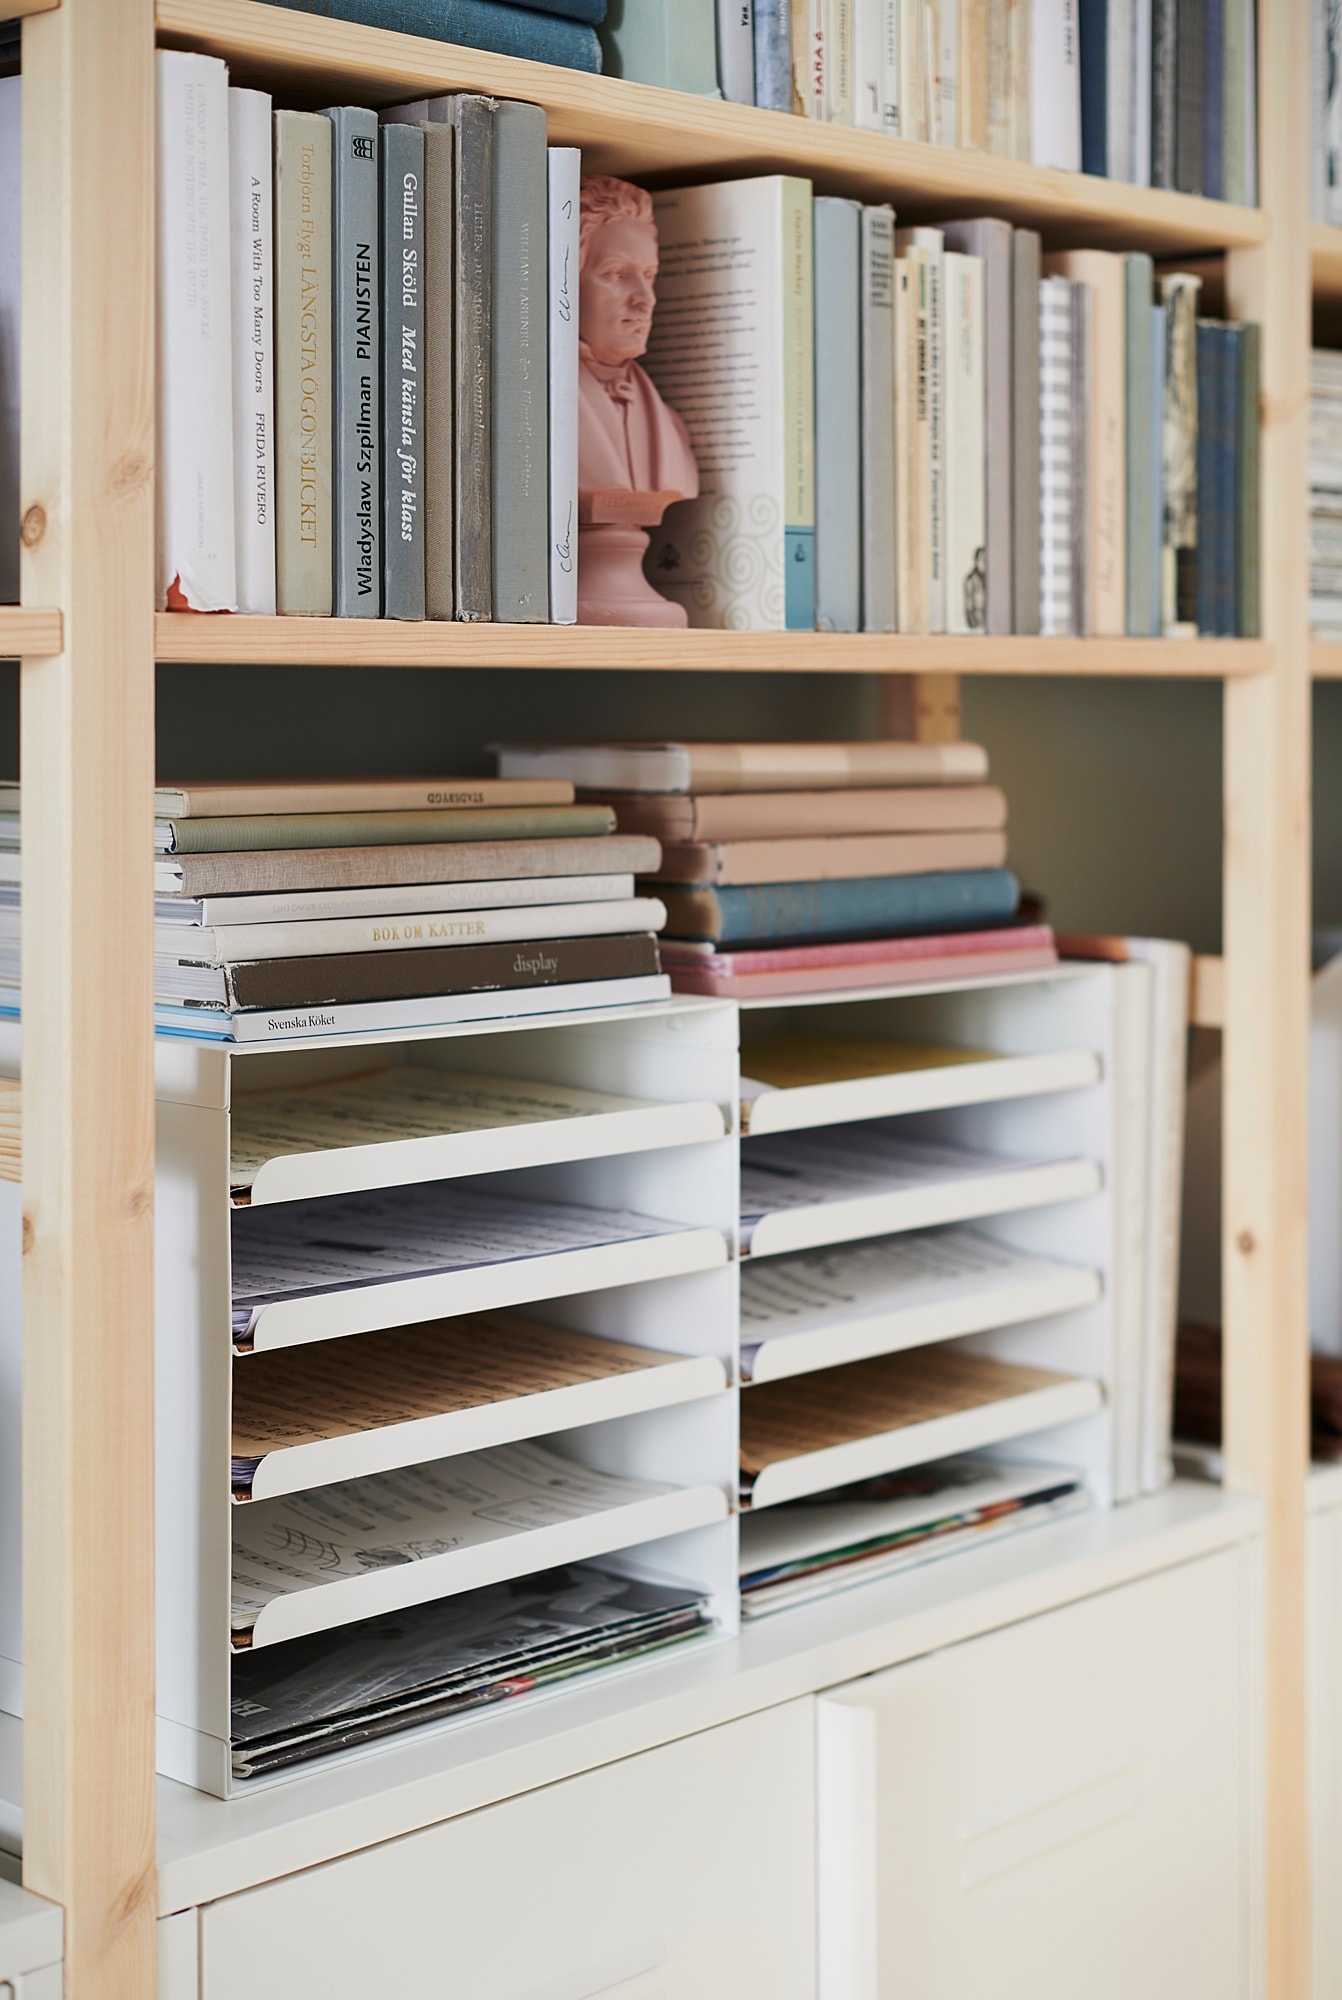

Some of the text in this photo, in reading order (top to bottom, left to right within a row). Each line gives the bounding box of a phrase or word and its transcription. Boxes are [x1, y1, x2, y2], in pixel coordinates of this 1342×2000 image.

[251, 176, 268, 525] A Room With Too Many Doors FRIDA RIVERO
[297, 144, 320, 548] Torbjörn Flygt LÄNGSTA ÖGONBLICKET
[356, 243, 375, 596] Wladyslaw Szpilman PIANISTEN
[397, 172, 417, 542] Gullan Sköld Med känsla för klass
[267, 1013, 335, 1030] Svenska Köket
[372, 920, 486, 942] BOK OM KATTER
[513, 953, 559, 975] display
